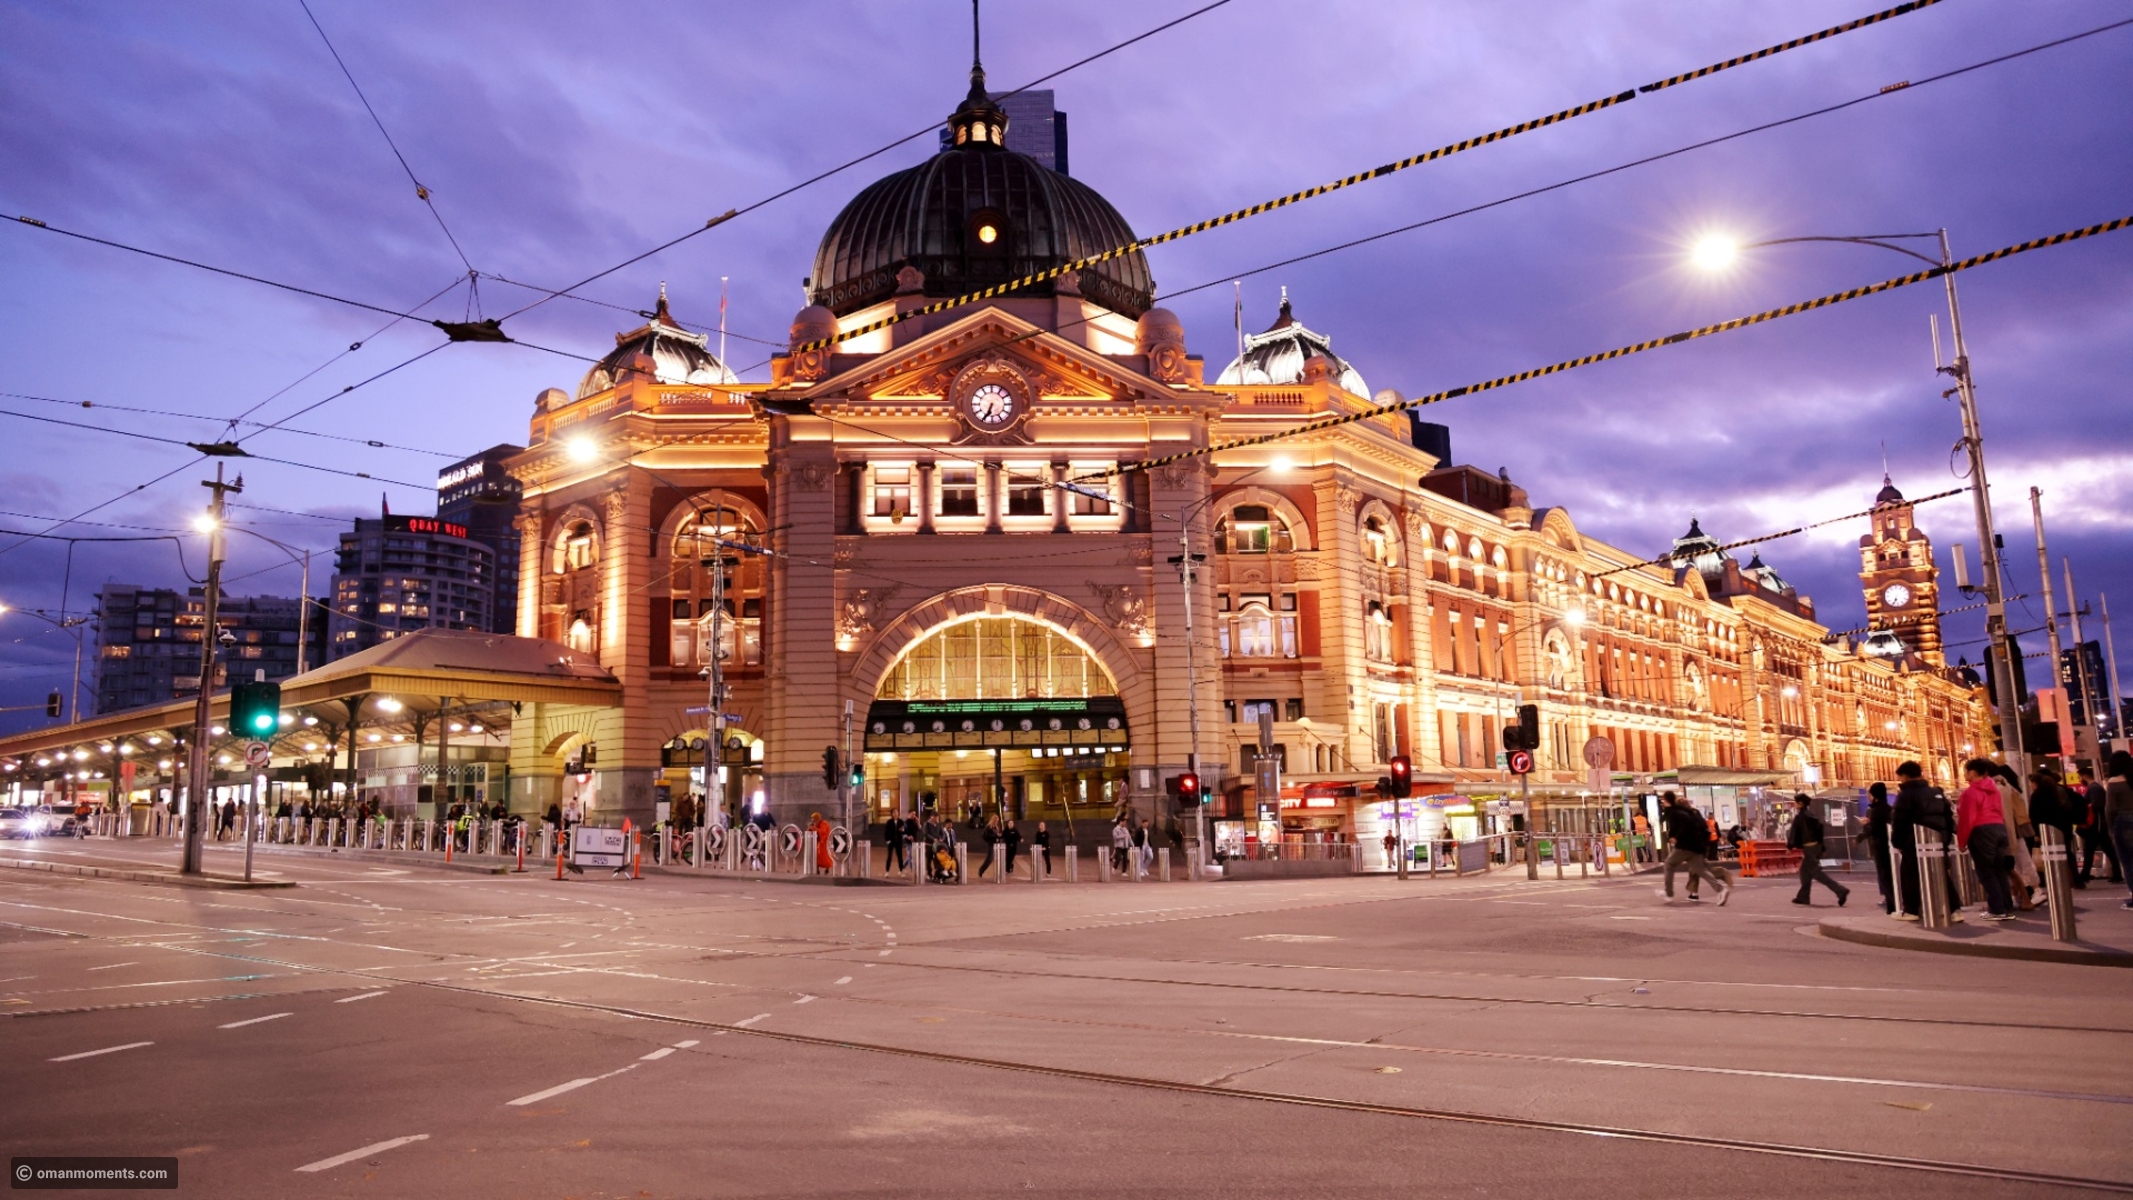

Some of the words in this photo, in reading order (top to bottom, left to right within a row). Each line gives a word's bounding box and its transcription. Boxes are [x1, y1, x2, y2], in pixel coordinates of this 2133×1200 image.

[437, 469, 466, 489] RALD
[409, 519, 440, 533] QUAY
[444, 523, 467, 539] WEST
[1280, 798, 1302, 808] CITY
